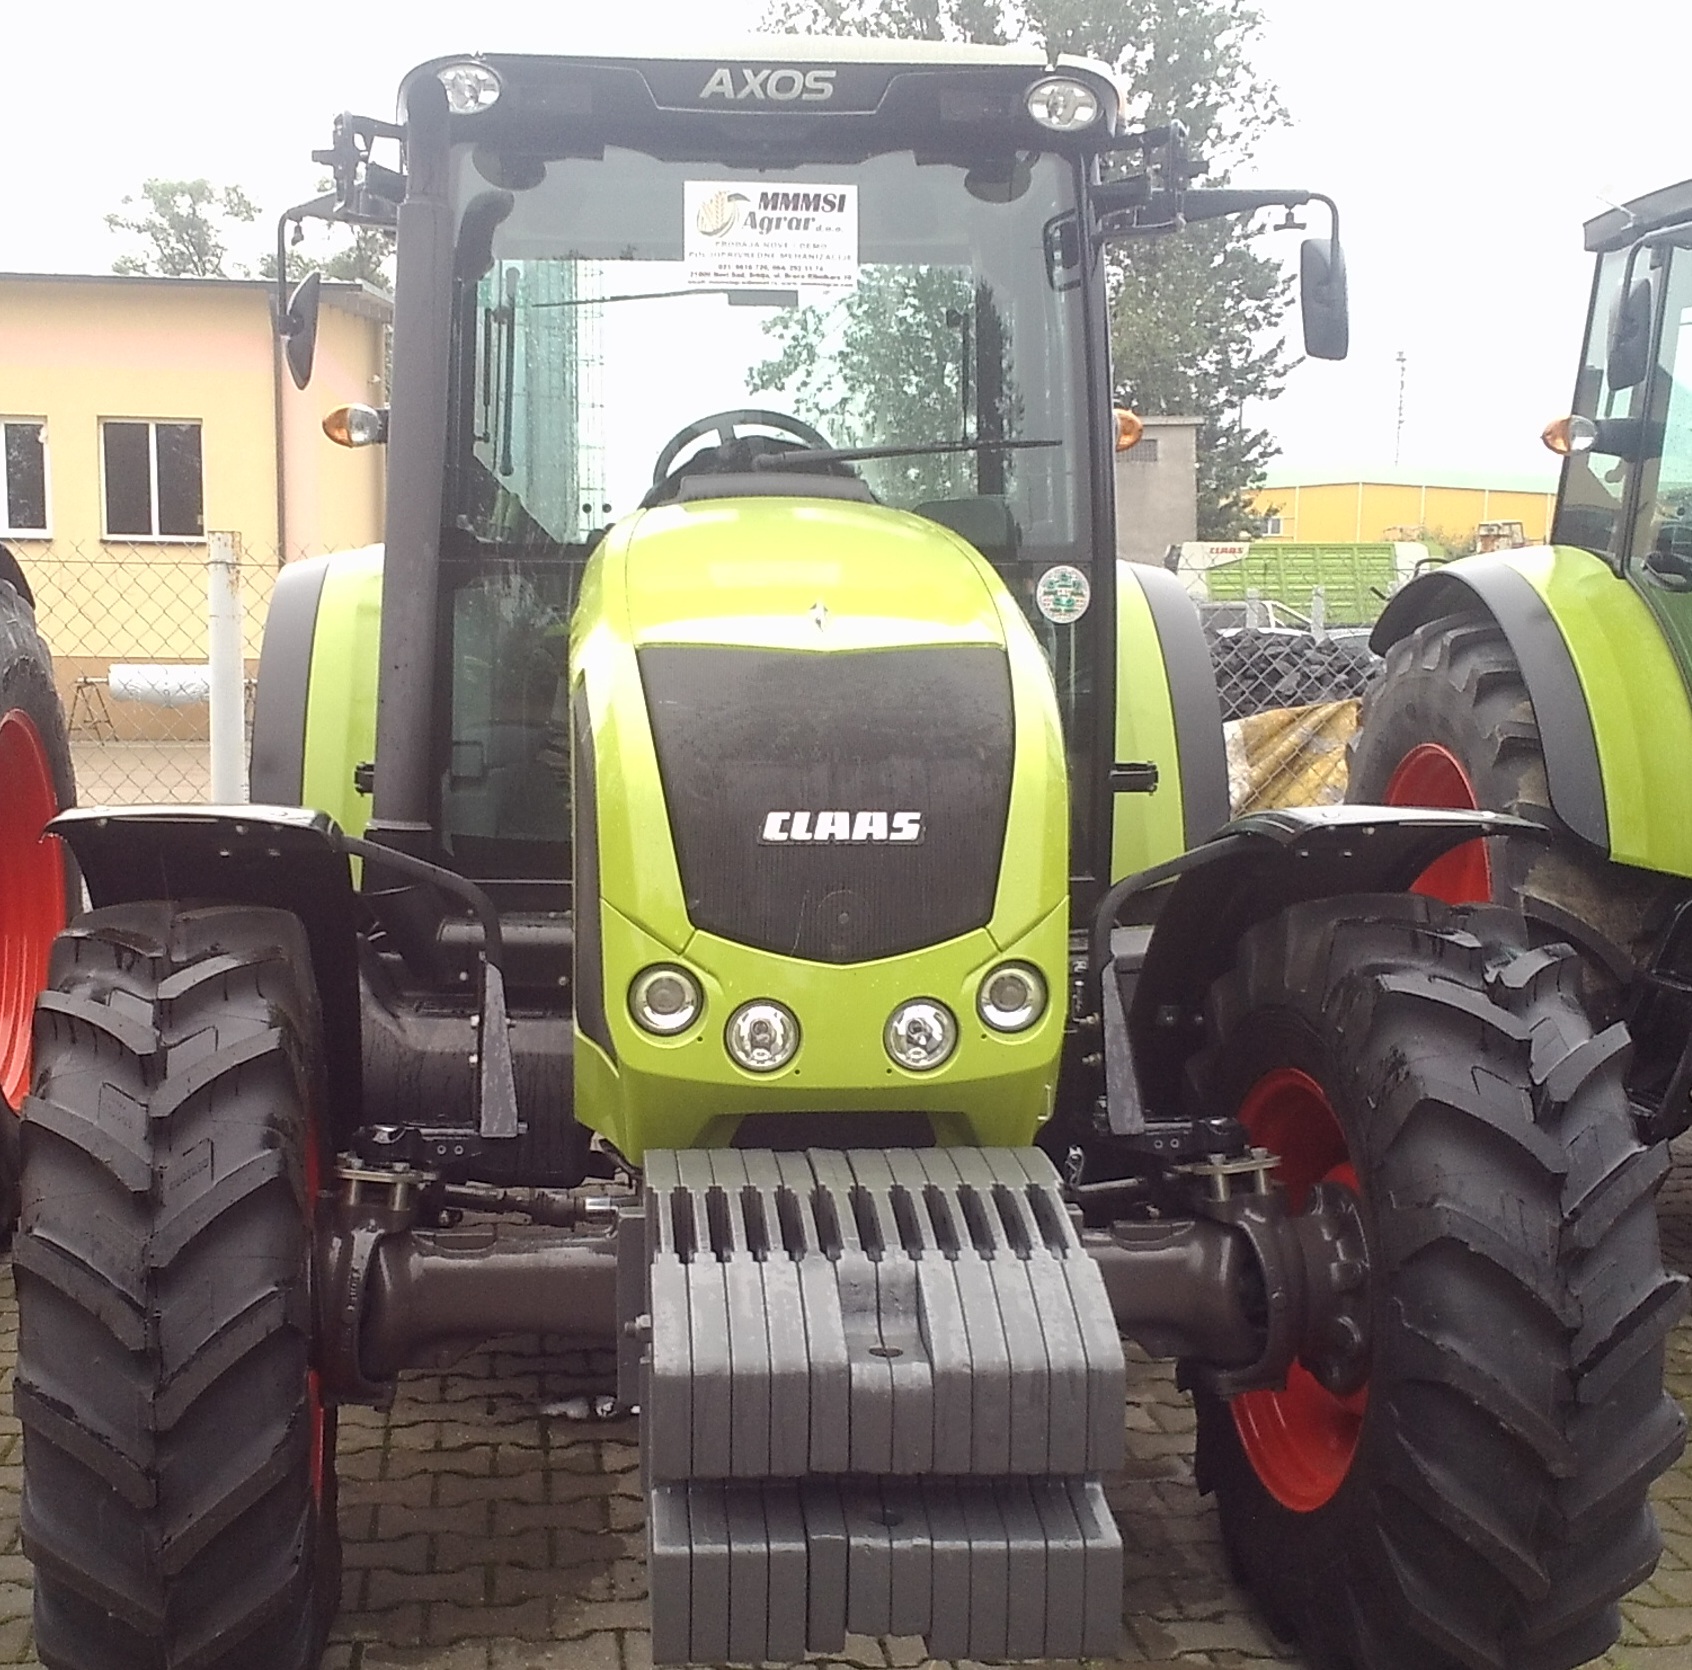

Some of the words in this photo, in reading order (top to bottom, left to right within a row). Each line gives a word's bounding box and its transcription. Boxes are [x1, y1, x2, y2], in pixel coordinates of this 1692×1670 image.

[700, 68, 837, 101] AXOS
[758, 191, 847, 213] MMMSI
[742, 211, 816, 235] Agrar
[1210, 547, 1244, 555] CLAAS
[762, 811, 922, 842] CLAAS
